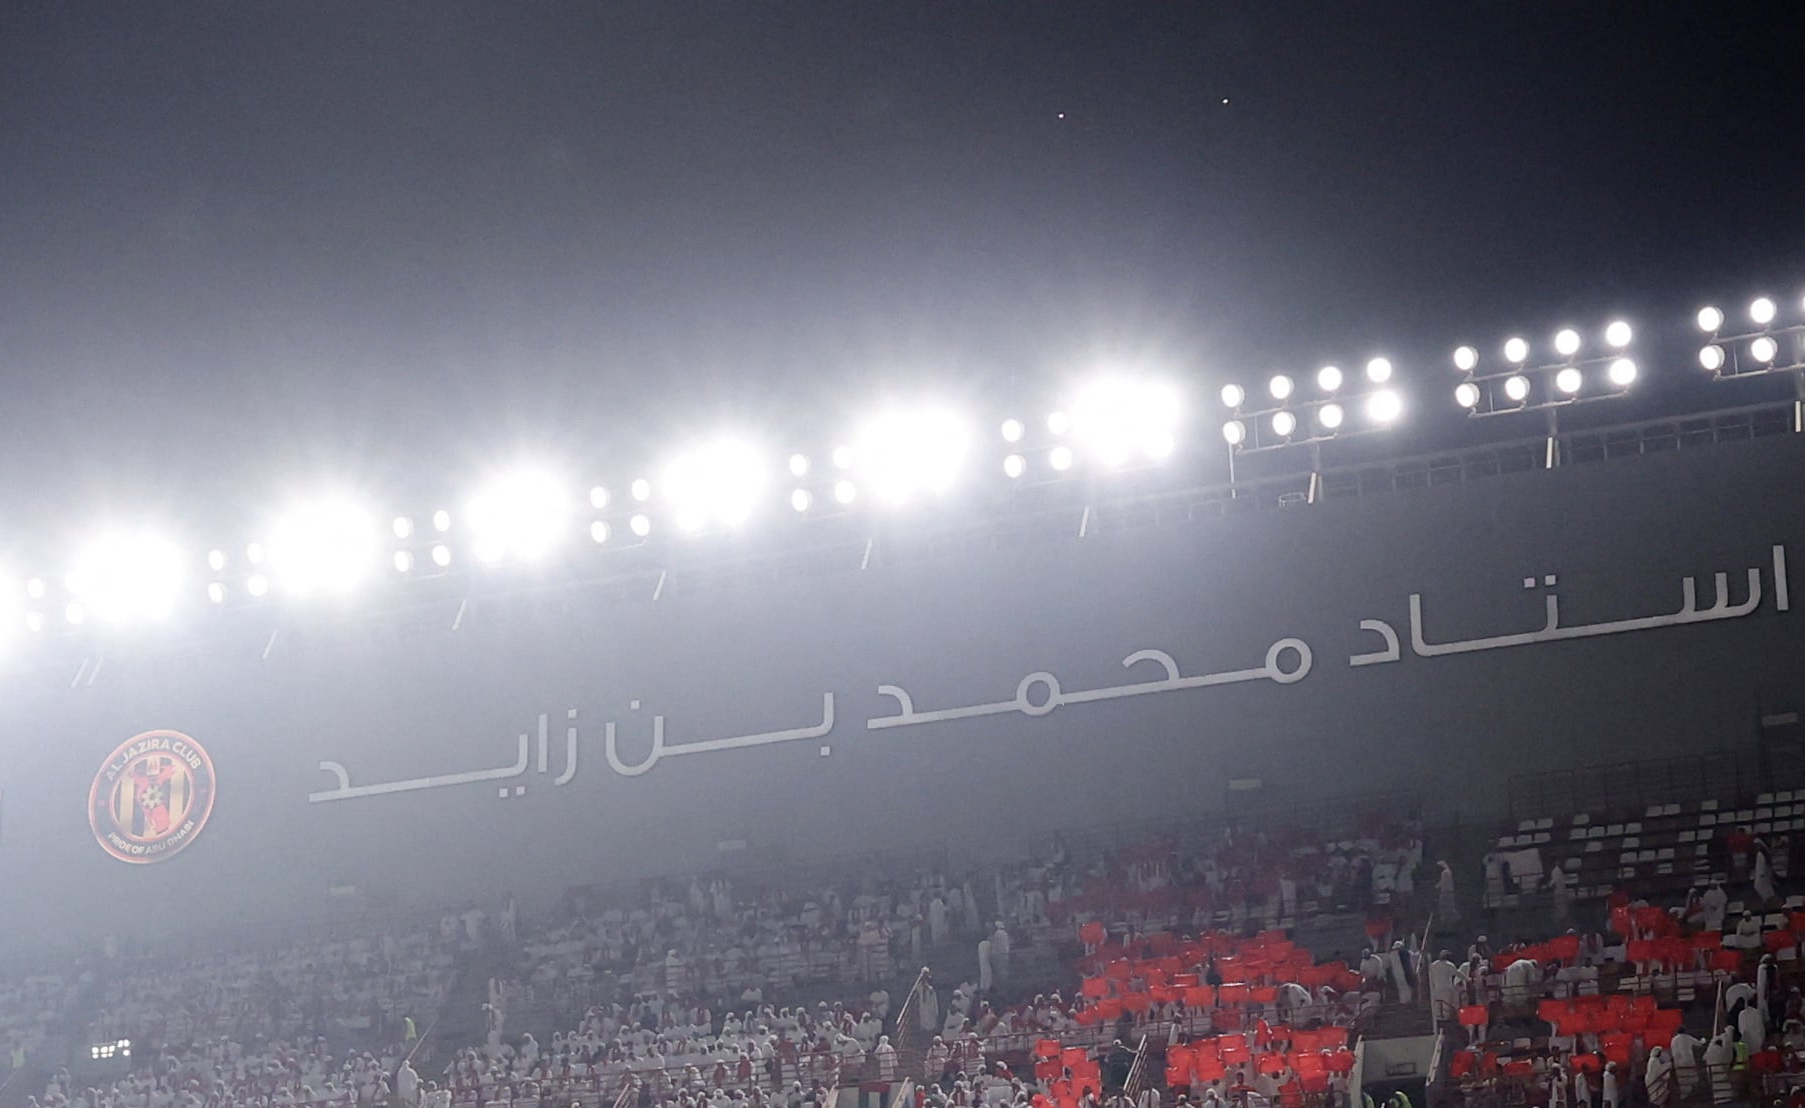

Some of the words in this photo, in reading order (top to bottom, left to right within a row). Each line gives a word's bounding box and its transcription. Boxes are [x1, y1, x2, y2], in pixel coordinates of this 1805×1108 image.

[1349, 544, 1791, 667] استاد
[866, 636, 1314, 729] محمد
[105, 763, 123, 782] AL
[121, 738, 170, 763] JAZIRA
[172, 741, 202, 770] CLUB
[308, 708, 578, 803] زايد
[605, 691, 835, 778] بن
[107, 832, 132, 854] PRIDE
[131, 845, 145, 855] OF
[145, 842, 166, 855] ABU
[166, 820, 195, 847] DHABI
